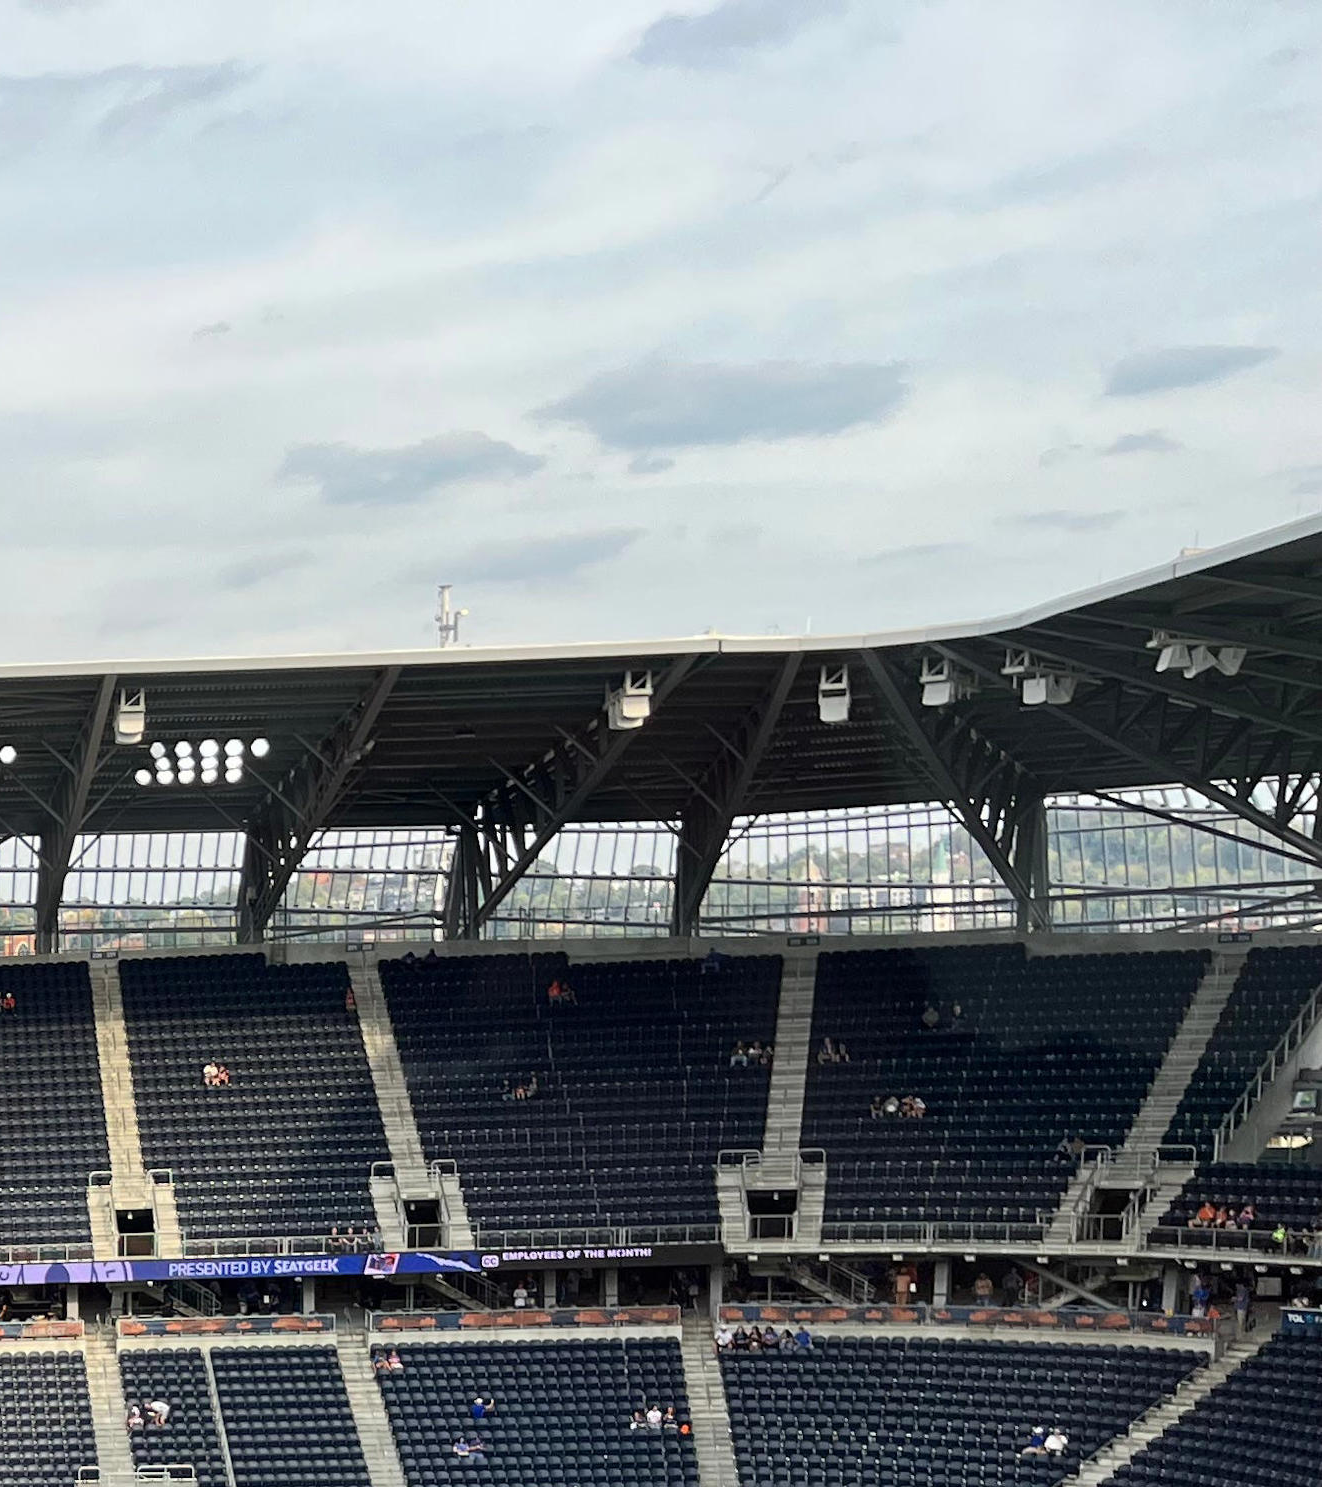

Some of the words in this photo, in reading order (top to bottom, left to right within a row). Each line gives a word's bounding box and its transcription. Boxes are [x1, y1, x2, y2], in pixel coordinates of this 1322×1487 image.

[502, 1251, 564, 1261] EMPLOYEES
[566, 1250, 580, 1259] OF
[584, 1249, 605, 1259] THE
[607, 1248, 652, 1258] MONTH!
[168, 1261, 248, 1277] PRESENTED
[251, 1261, 271, 1275] BY
[274, 1258, 339, 1274] SEATGEEK
